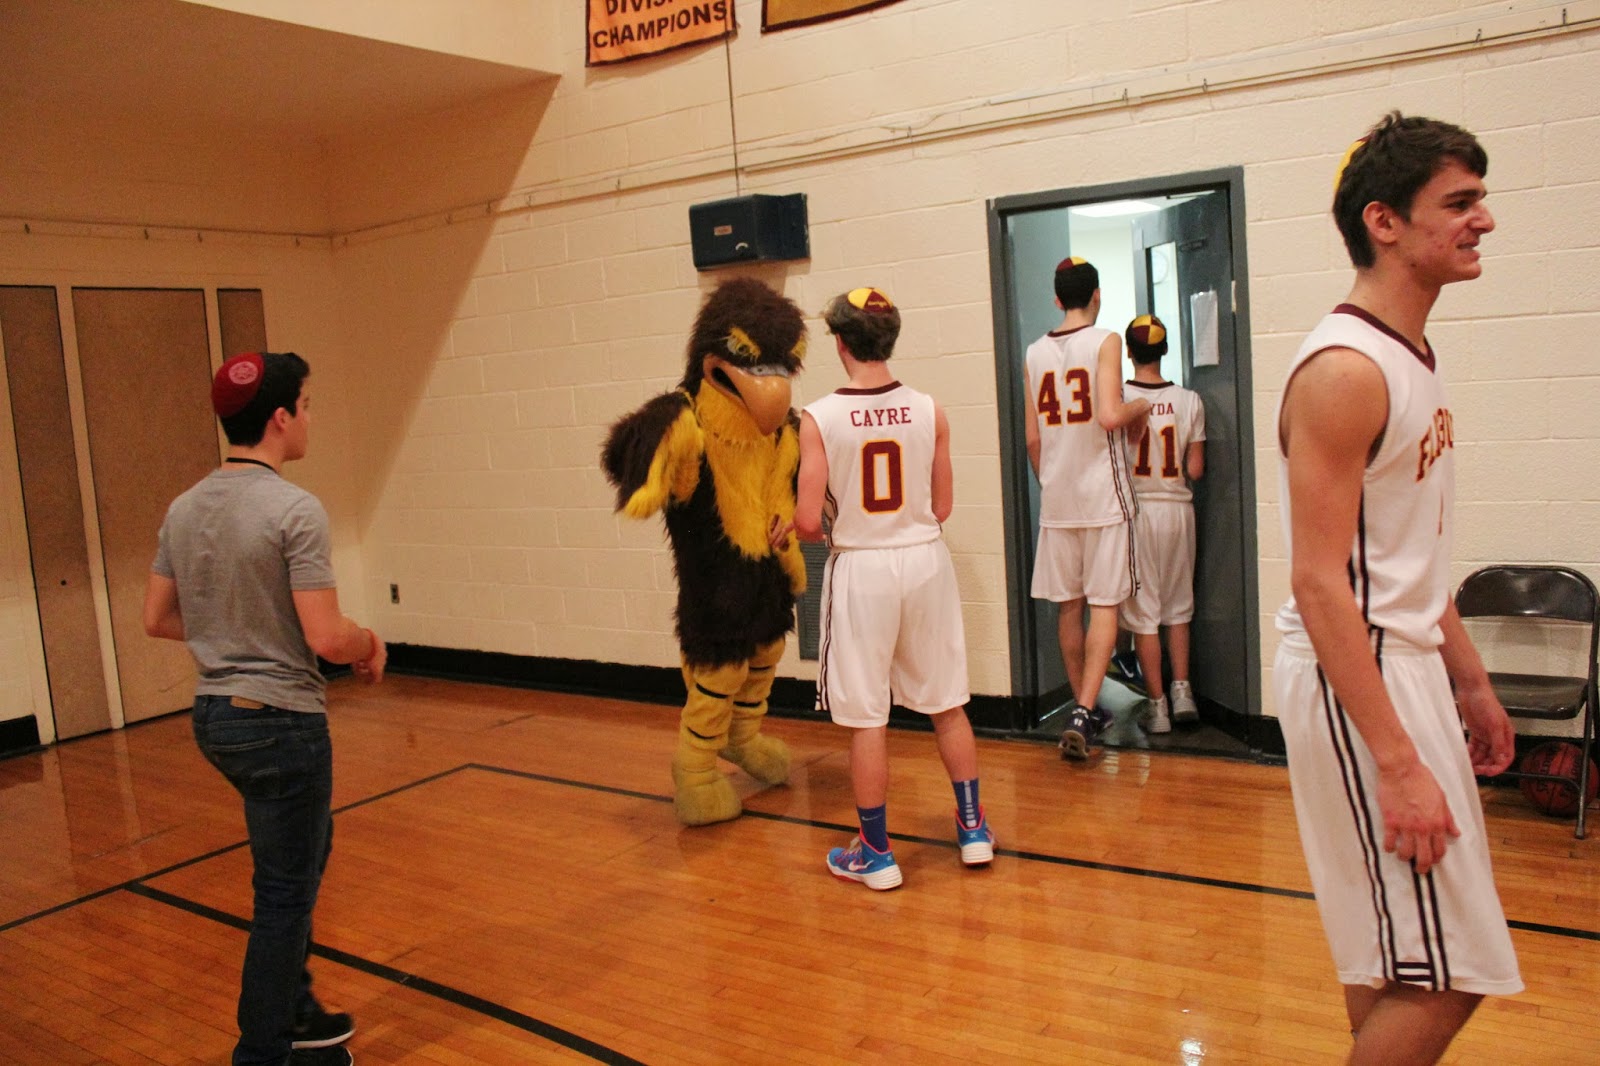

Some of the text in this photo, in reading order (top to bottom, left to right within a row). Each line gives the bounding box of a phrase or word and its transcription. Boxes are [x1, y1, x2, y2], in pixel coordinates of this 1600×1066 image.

[592, 1, 727, 48] CHAMPIONS
[606, 0, 673, 16] DIVI
[850, 407, 912, 427] CAYRE
[1037, 367, 1093, 427] 43
[1133, 424, 1179, 478] 11
[861, 438, 905, 515] 0
